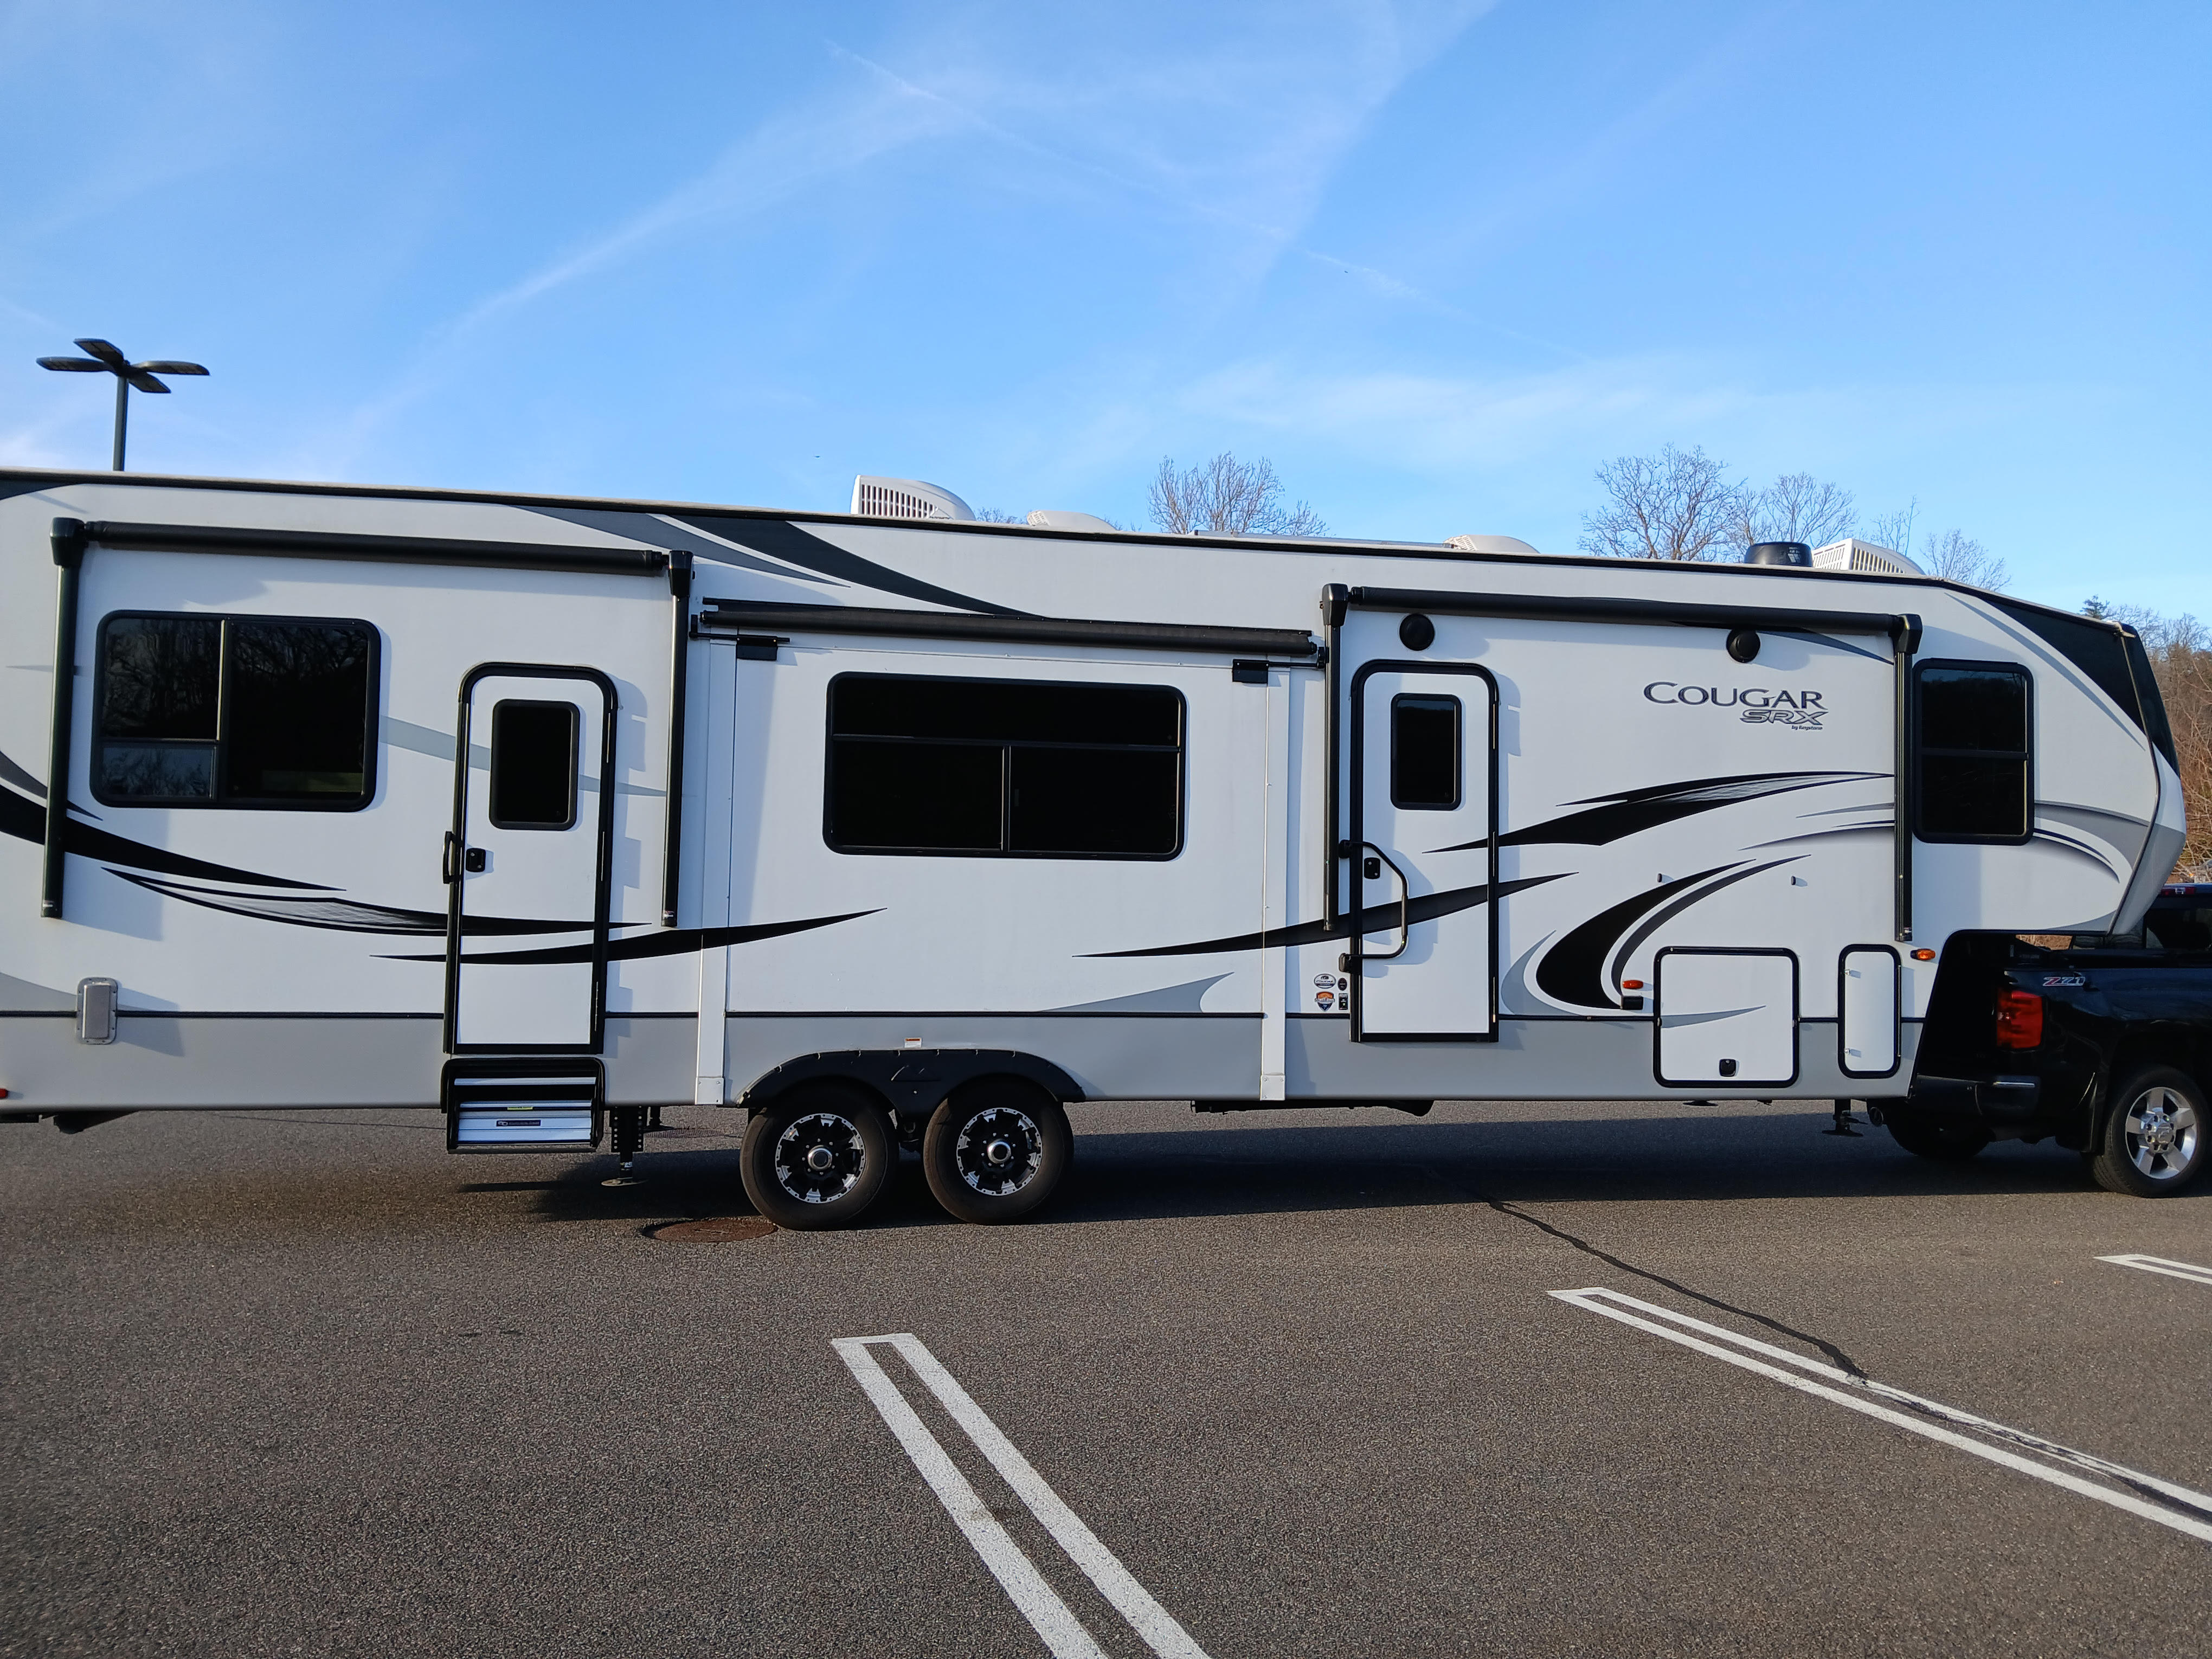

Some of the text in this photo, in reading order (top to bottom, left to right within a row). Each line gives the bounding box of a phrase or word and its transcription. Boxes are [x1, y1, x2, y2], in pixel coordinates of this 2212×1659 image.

[1643, 681, 1828, 710] COUGAR
[1739, 709, 1829, 725] SRX
[2042, 976, 2086, 986] Z71
